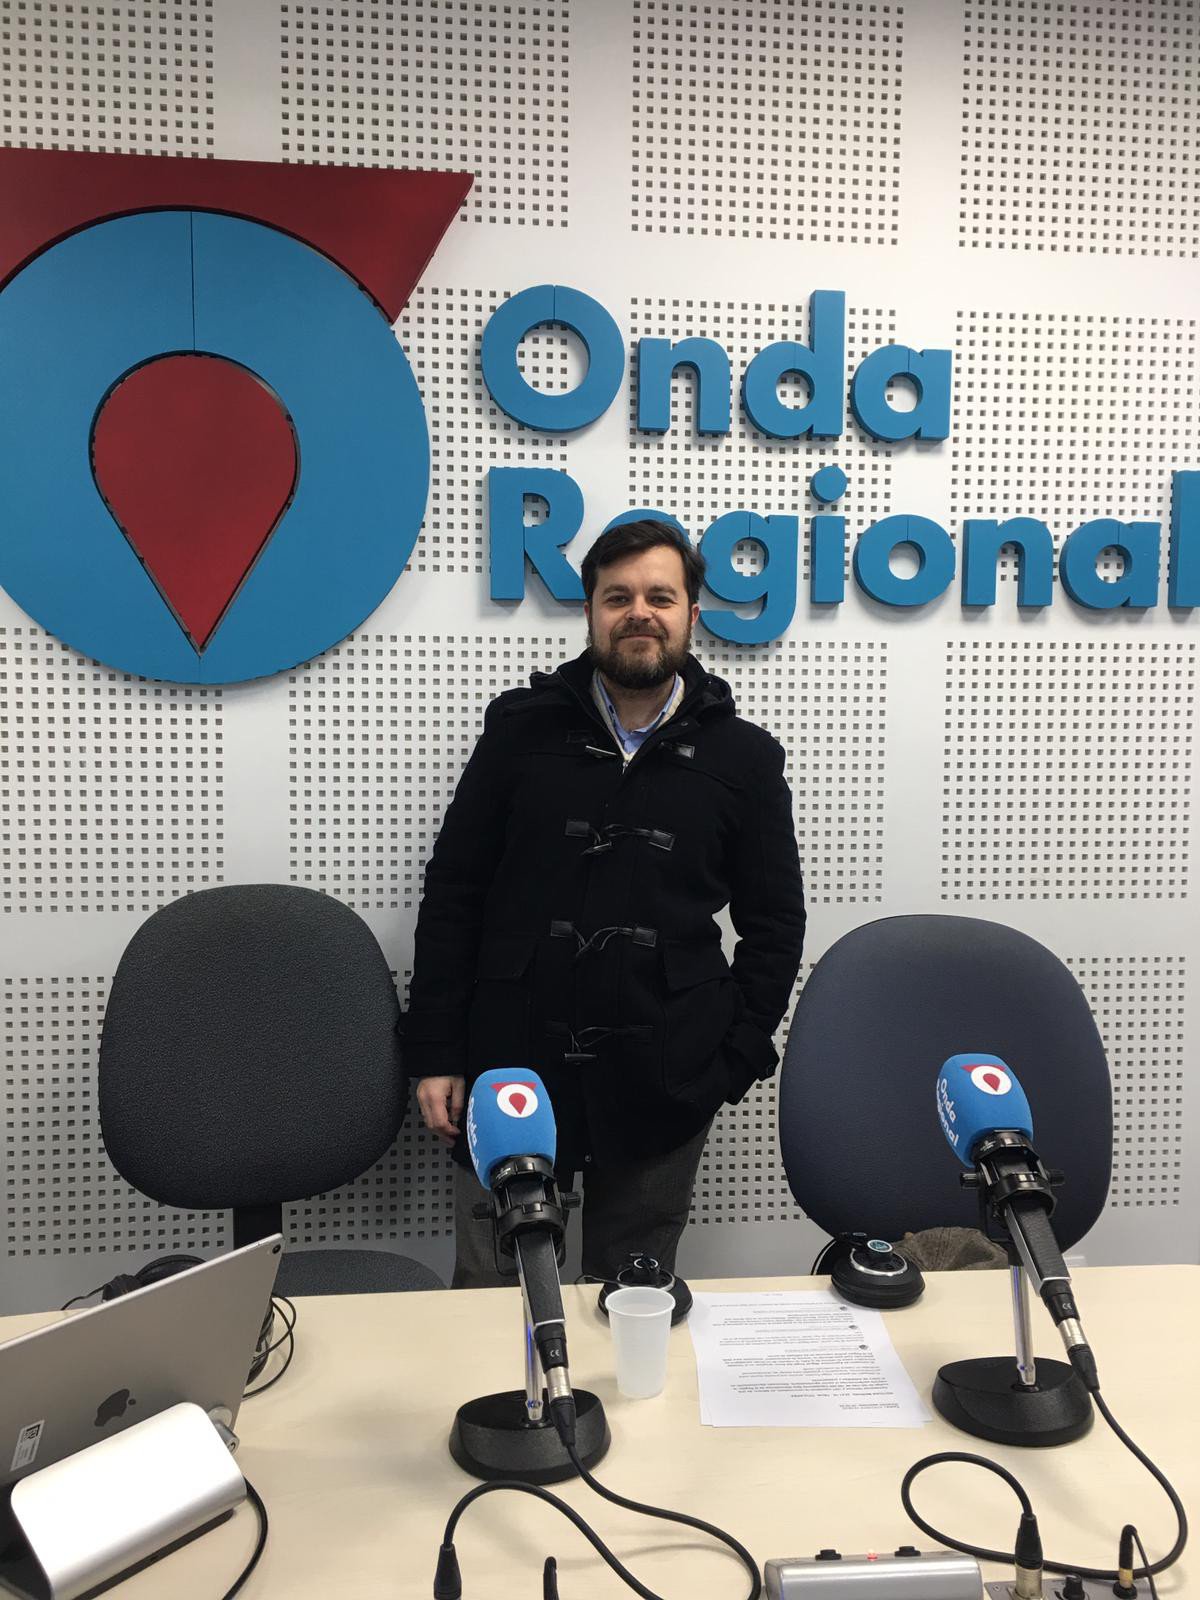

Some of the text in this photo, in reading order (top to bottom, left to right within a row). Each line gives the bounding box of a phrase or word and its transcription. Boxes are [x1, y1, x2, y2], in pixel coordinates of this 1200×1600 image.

[481, 284, 952, 442] Onda
[488, 465, 1200, 645] Rgional
[940, 1078, 957, 1123] Onda
